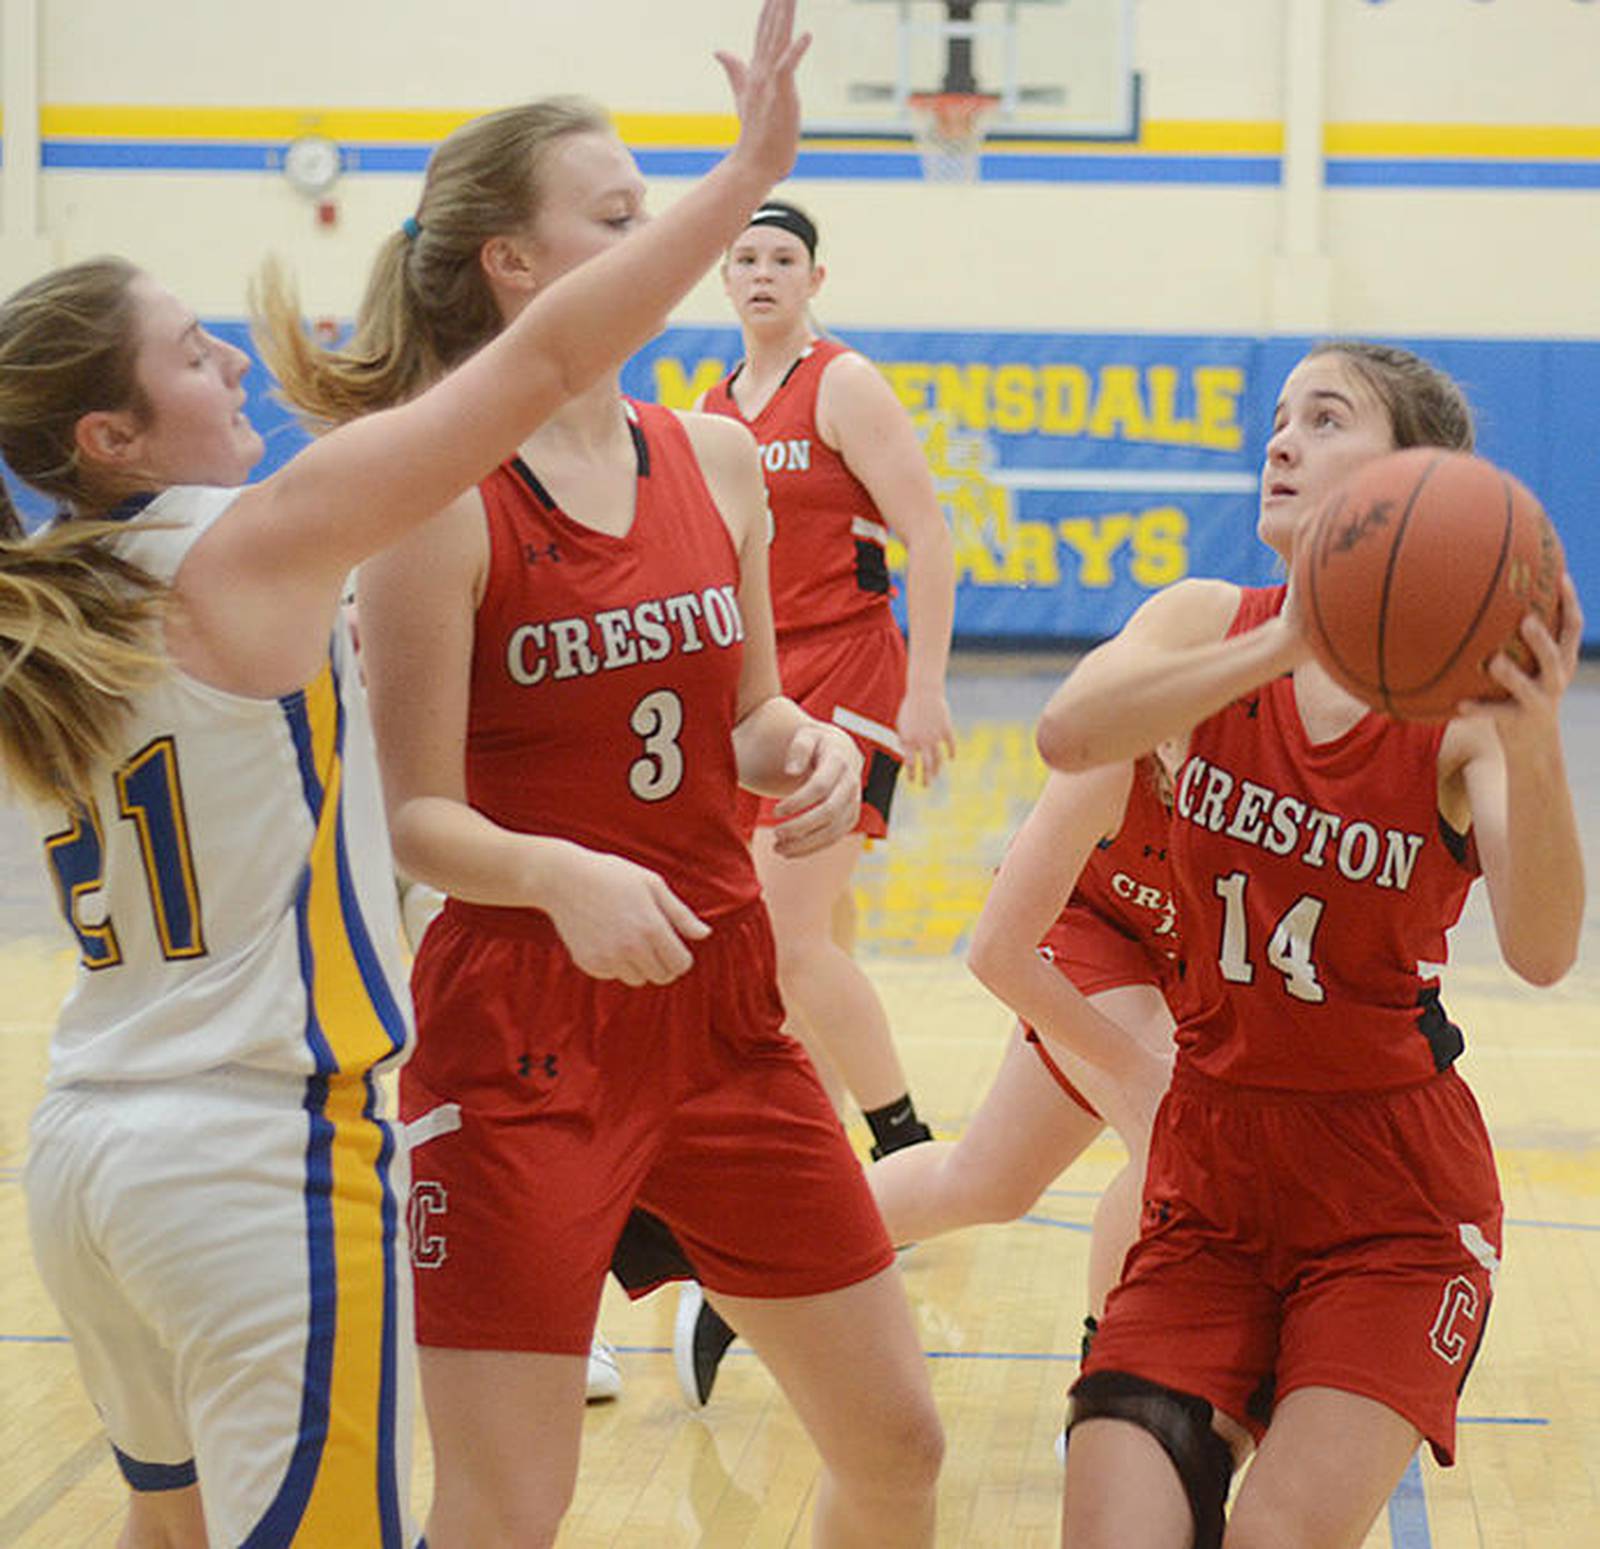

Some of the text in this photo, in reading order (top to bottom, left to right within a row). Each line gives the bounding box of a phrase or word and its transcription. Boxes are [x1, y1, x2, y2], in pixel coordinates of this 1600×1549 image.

[654, 358, 1246, 453] MENSDALE
[628, 688, 685, 802] 3
[44, 735, 209, 971] 21
[1176, 755, 1425, 892] CRESTON
[1215, 871, 1326, 1004] 14
[410, 1181, 448, 1269] C
[1428, 1275, 1479, 1366] C
